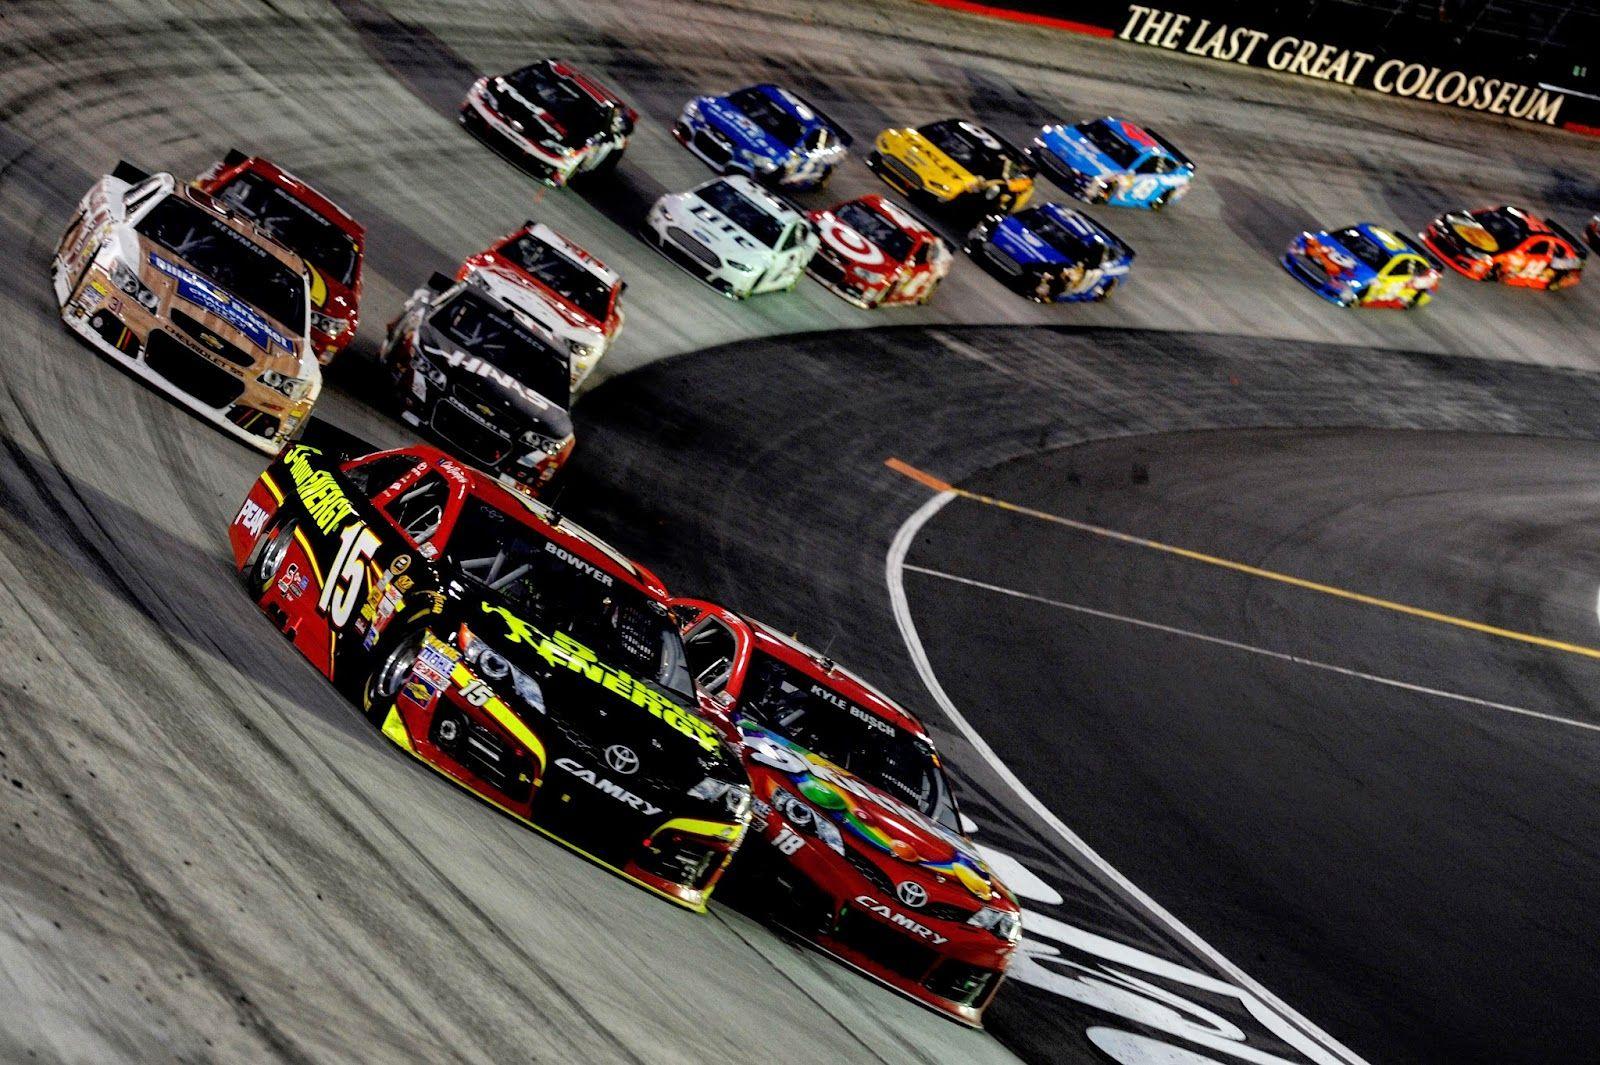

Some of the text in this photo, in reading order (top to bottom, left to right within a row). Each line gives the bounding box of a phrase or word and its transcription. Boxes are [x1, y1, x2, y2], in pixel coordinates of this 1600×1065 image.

[1117, 4, 1565, 125] THE LAST GREAT COLOSSEUM
[234, 498, 270, 541] PEAK
[296, 469, 354, 536] ENERGY
[316, 519, 384, 628] 15
[544, 541, 614, 588] BOWYER
[458, 679, 495, 707] 15
[538, 637, 722, 753] ENERGY
[810, 684, 896, 738] KYLE BUSCH
[554, 757, 662, 816] CAMRY
[770, 827, 806, 856] 18
[854, 895, 949, 945] CAMRY
